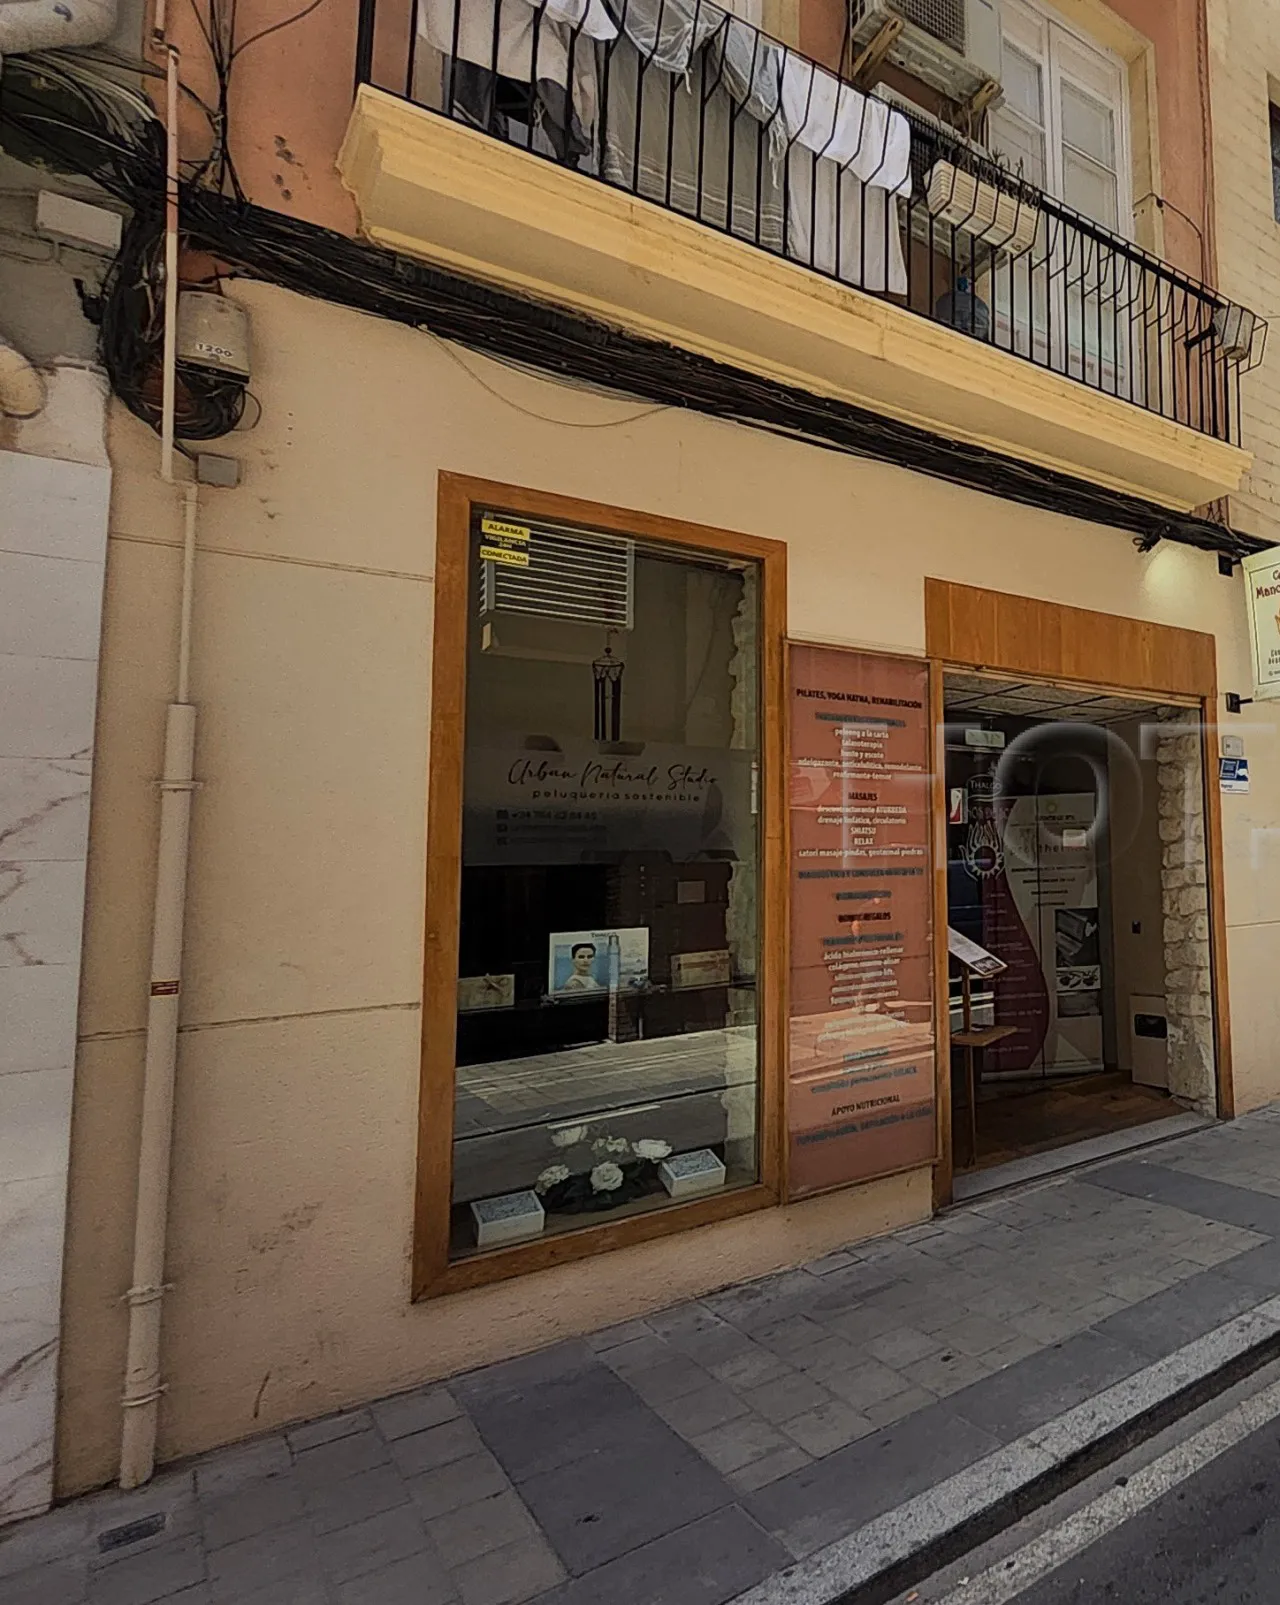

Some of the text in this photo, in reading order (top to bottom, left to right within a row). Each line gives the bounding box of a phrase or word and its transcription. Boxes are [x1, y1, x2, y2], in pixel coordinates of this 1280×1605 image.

[198, 343, 233, 357] 1200
[488, 524, 524, 536] ALARMA
[481, 550, 527, 562] CONECTADA
[796, 688, 825, 699] PILATES,
[507, 758, 718, 790] Urban Natural Studio
[624, 792, 700, 802] sostenible
[848, 792, 878, 801] MASAJES
[831, 1095, 900, 1116] APOYO NUTRICIONAL
